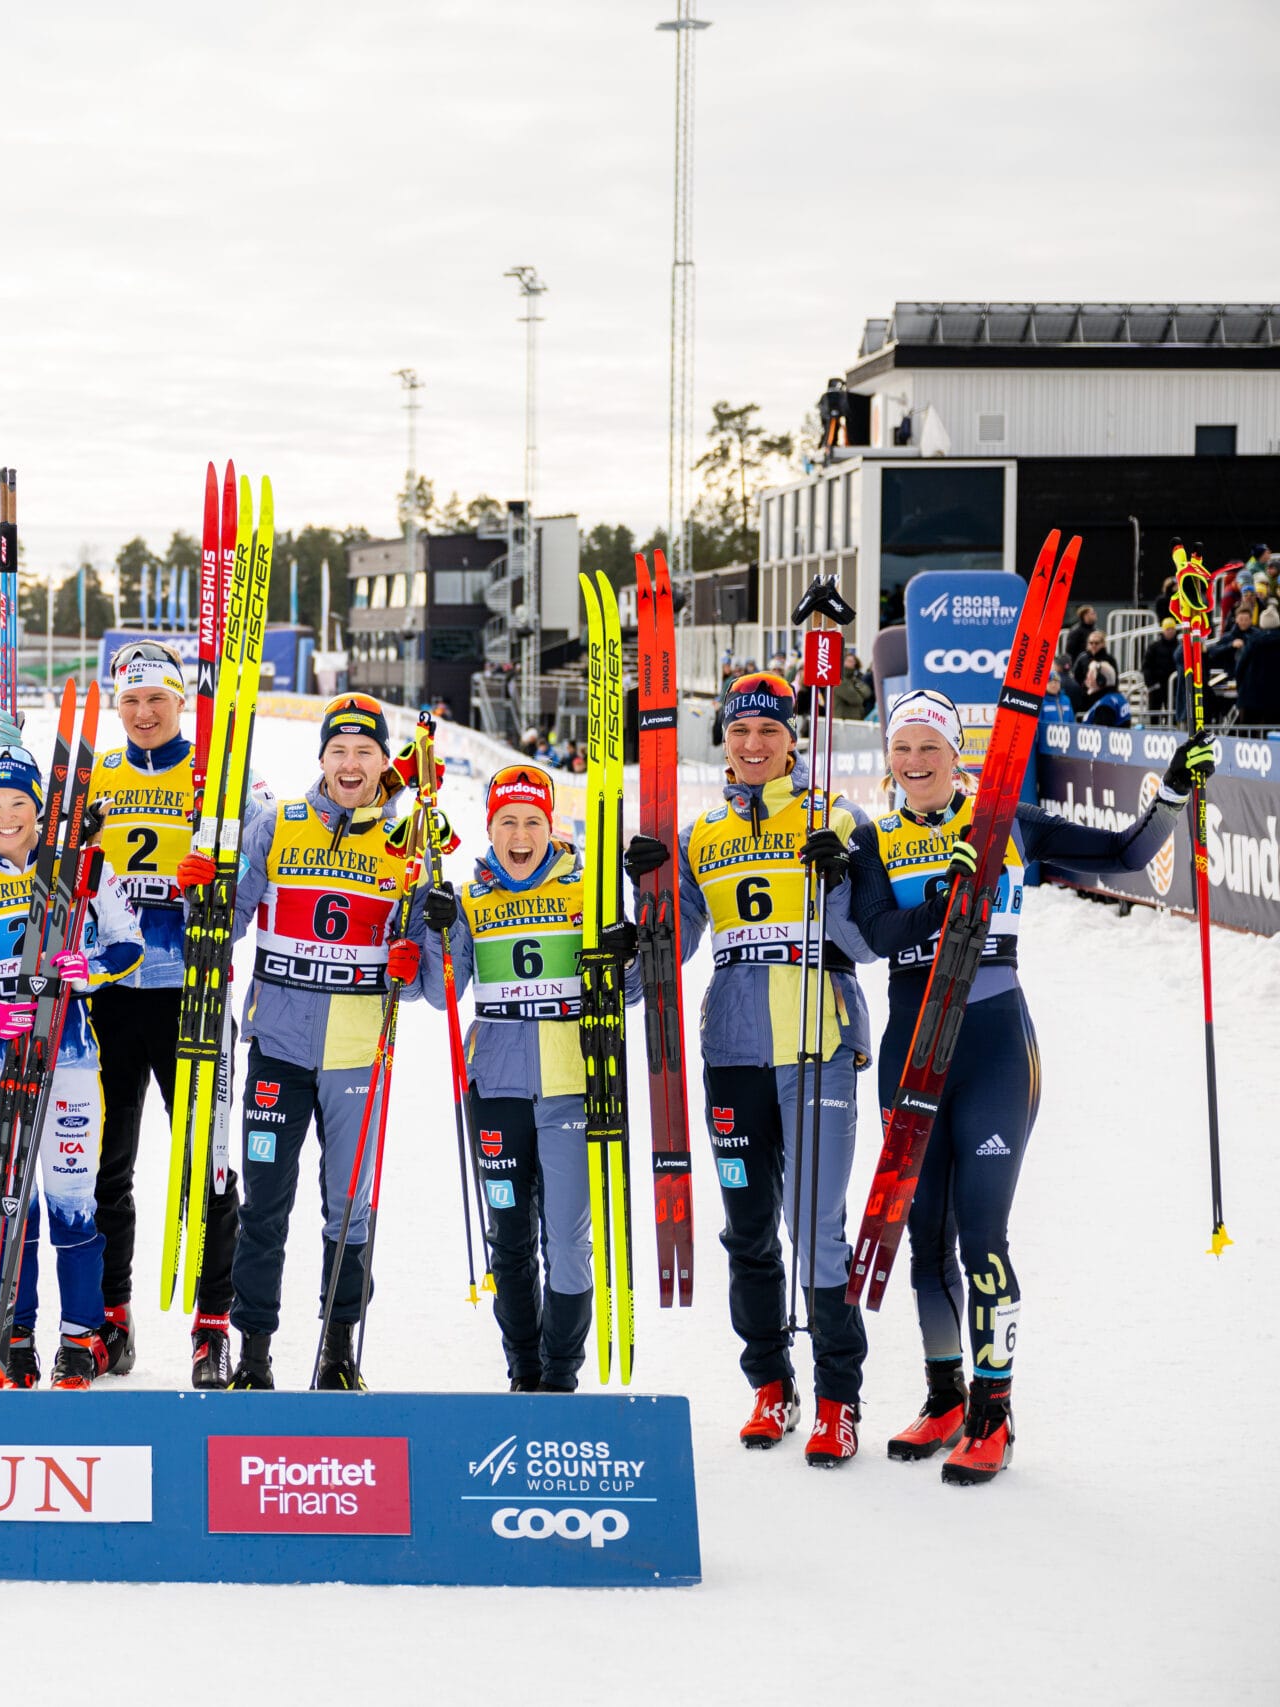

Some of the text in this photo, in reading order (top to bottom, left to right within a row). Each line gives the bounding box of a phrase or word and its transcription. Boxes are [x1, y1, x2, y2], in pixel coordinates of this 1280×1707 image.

[201, 550, 216, 645] MADSHUS
[225, 543, 249, 663] FISCHER
[246, 544, 270, 664] FISCHER
[952, 596, 1001, 607] CROSS
[952, 606, 1018, 618] COUNTRY
[952, 617, 1015, 626] WORLD CUP
[923, 648, 1010, 679] coop
[1013, 632, 1030, 680] ATOMIC
[1032, 639, 1050, 686] ATOMIC
[644, 653, 652, 698] ATOMIC
[661, 650, 670, 695] ATOMIC
[589, 641, 601, 764] FISCHER
[608, 638, 619, 762] FISCHER
[1010, 697, 1039, 710] ATOMIC
[647, 715, 673, 725] ATOMIC
[1046, 724, 1272, 778] coop coop coop coop
[114, 786, 185, 808] GRUYÈRE
[46, 789, 64, 847] ROSSIGNOL
[68, 791, 86, 850] ROSSIGNOL
[126, 827, 160, 872] 2
[699, 831, 796, 863] LE GRUYÈRE
[887, 841, 902, 860] LE
[280, 847, 379, 875] LE GRUYÈRE
[700, 851, 791, 873] SWITZERLAND
[281, 867, 374, 884] SWITZERLAND
[473, 896, 568, 925] LE GRUYÈRE
[735, 876, 774, 923] 6
[1013, 889, 1022, 911] 6
[312, 892, 351, 942] 6
[477, 914, 565, 932] SWITZERLAND
[85, 926, 95, 945] 2
[264, 954, 381, 985] GUIDE
[511, 938, 545, 980] 6
[217, 1050, 228, 1103] REDLINE
[68, 1101, 91, 1110] SVENSKA
[246, 1107, 286, 1124] WÜRTH
[909, 1100, 938, 1112] ATOMIC
[66, 1116, 83, 1126] Ford
[586, 1129, 623, 1137] FISCHER
[59, 1141, 85, 1154] ICA
[252, 1134, 272, 1159] TQ
[712, 1134, 750, 1148] WÜRTH
[976, 1145, 1012, 1156] adidas
[52, 1165, 88, 1174] SCANIA
[478, 1156, 517, 1170] WÜRTH
[722, 1162, 743, 1184] TQ
[490, 1183, 508, 1204] TQ
[1005, 1321, 1017, 1353] 6
[218, 1336, 230, 1380] MADSHUS
[525, 1440, 611, 1459] CROSS
[240, 1455, 377, 1487] Prioritet
[526, 1459, 646, 1479] COUNTRY
[527, 1479, 637, 1492] WORLD CUP
[258, 1484, 359, 1516] Finans
[490, 1507, 630, 1548] coop
